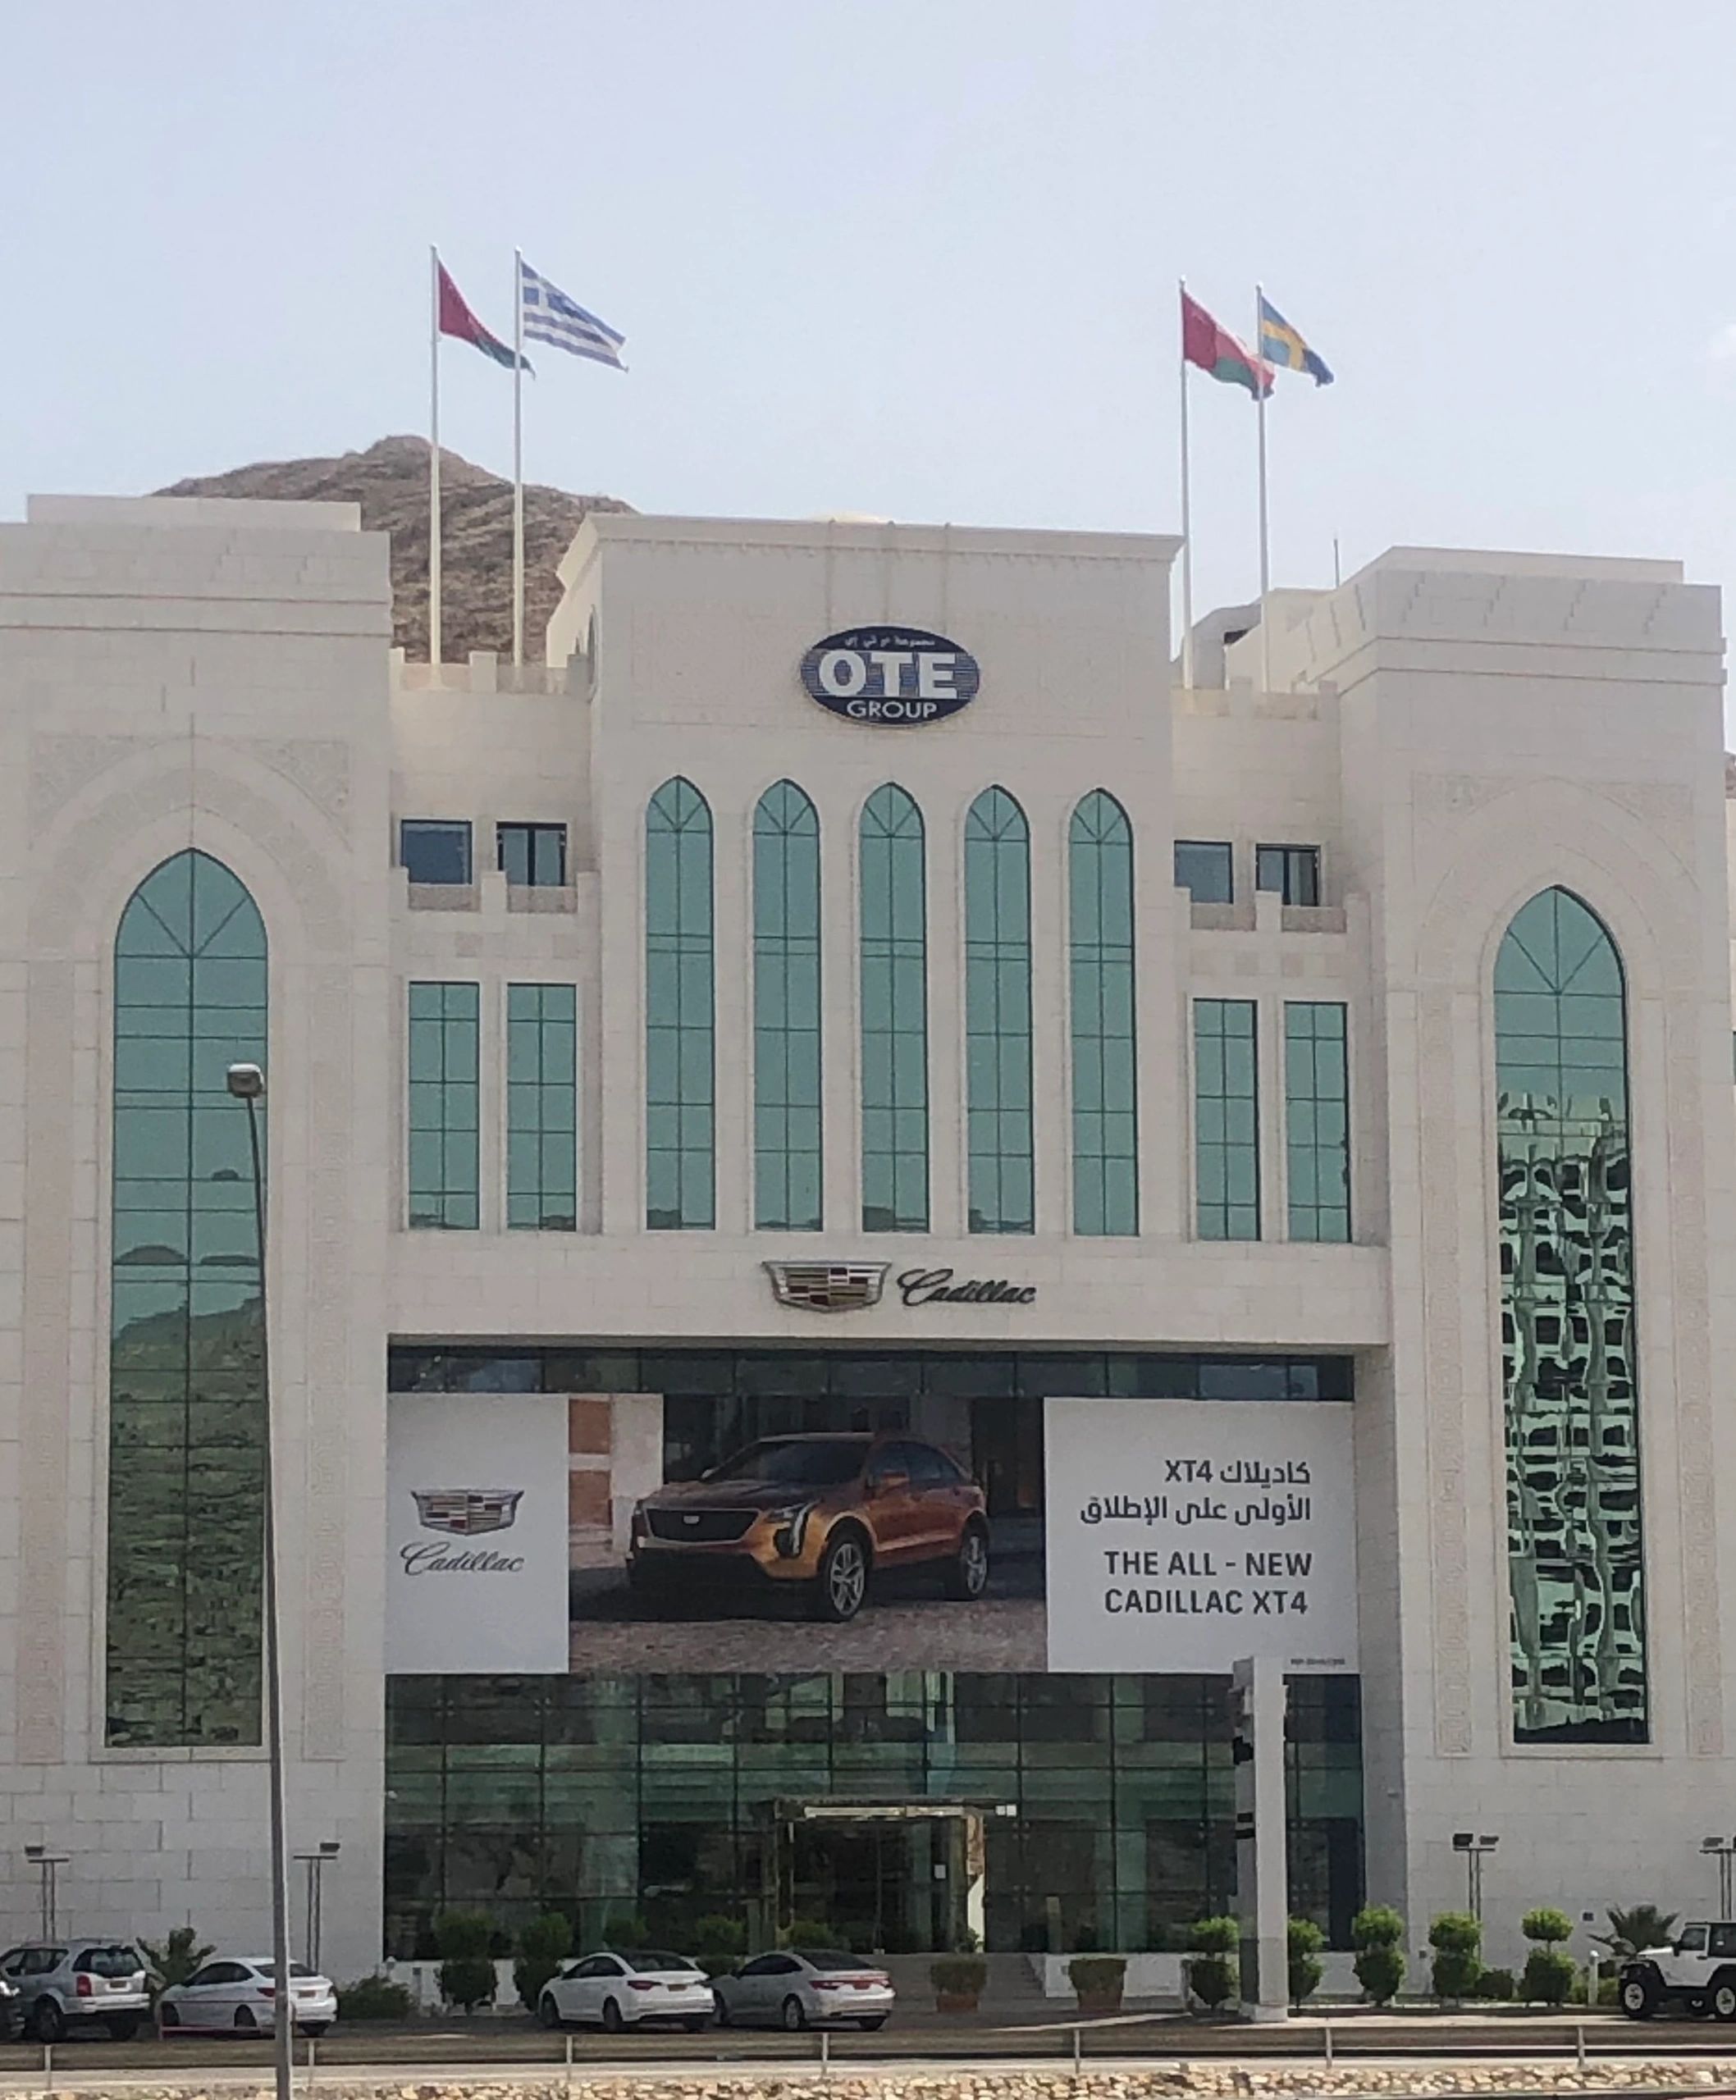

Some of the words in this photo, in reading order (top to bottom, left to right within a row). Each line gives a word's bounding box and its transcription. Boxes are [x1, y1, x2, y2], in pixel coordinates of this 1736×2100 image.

[820, 650, 958, 699] OTE
[847, 700, 937, 718] GROUP
[897, 1268, 1036, 1306] Cadillac
[1165, 1459, 1213, 1483] XT4
[1219, 1460, 1311, 1489] كاديلاك
[1080, 1495, 1167, 1526] الإطلاق
[1176, 1497, 1227, 1526] على
[1234, 1494, 1311, 1526] الأولى
[400, 1541, 525, 1576] Cadillac
[1103, 1551, 1158, 1576] THE
[1167, 1551, 1217, 1577] ALL
[1245, 1553, 1313, 1577] NEW
[1104, 1589, 1243, 1615] CADILLAC
[1252, 1591, 1309, 1615] XT4
